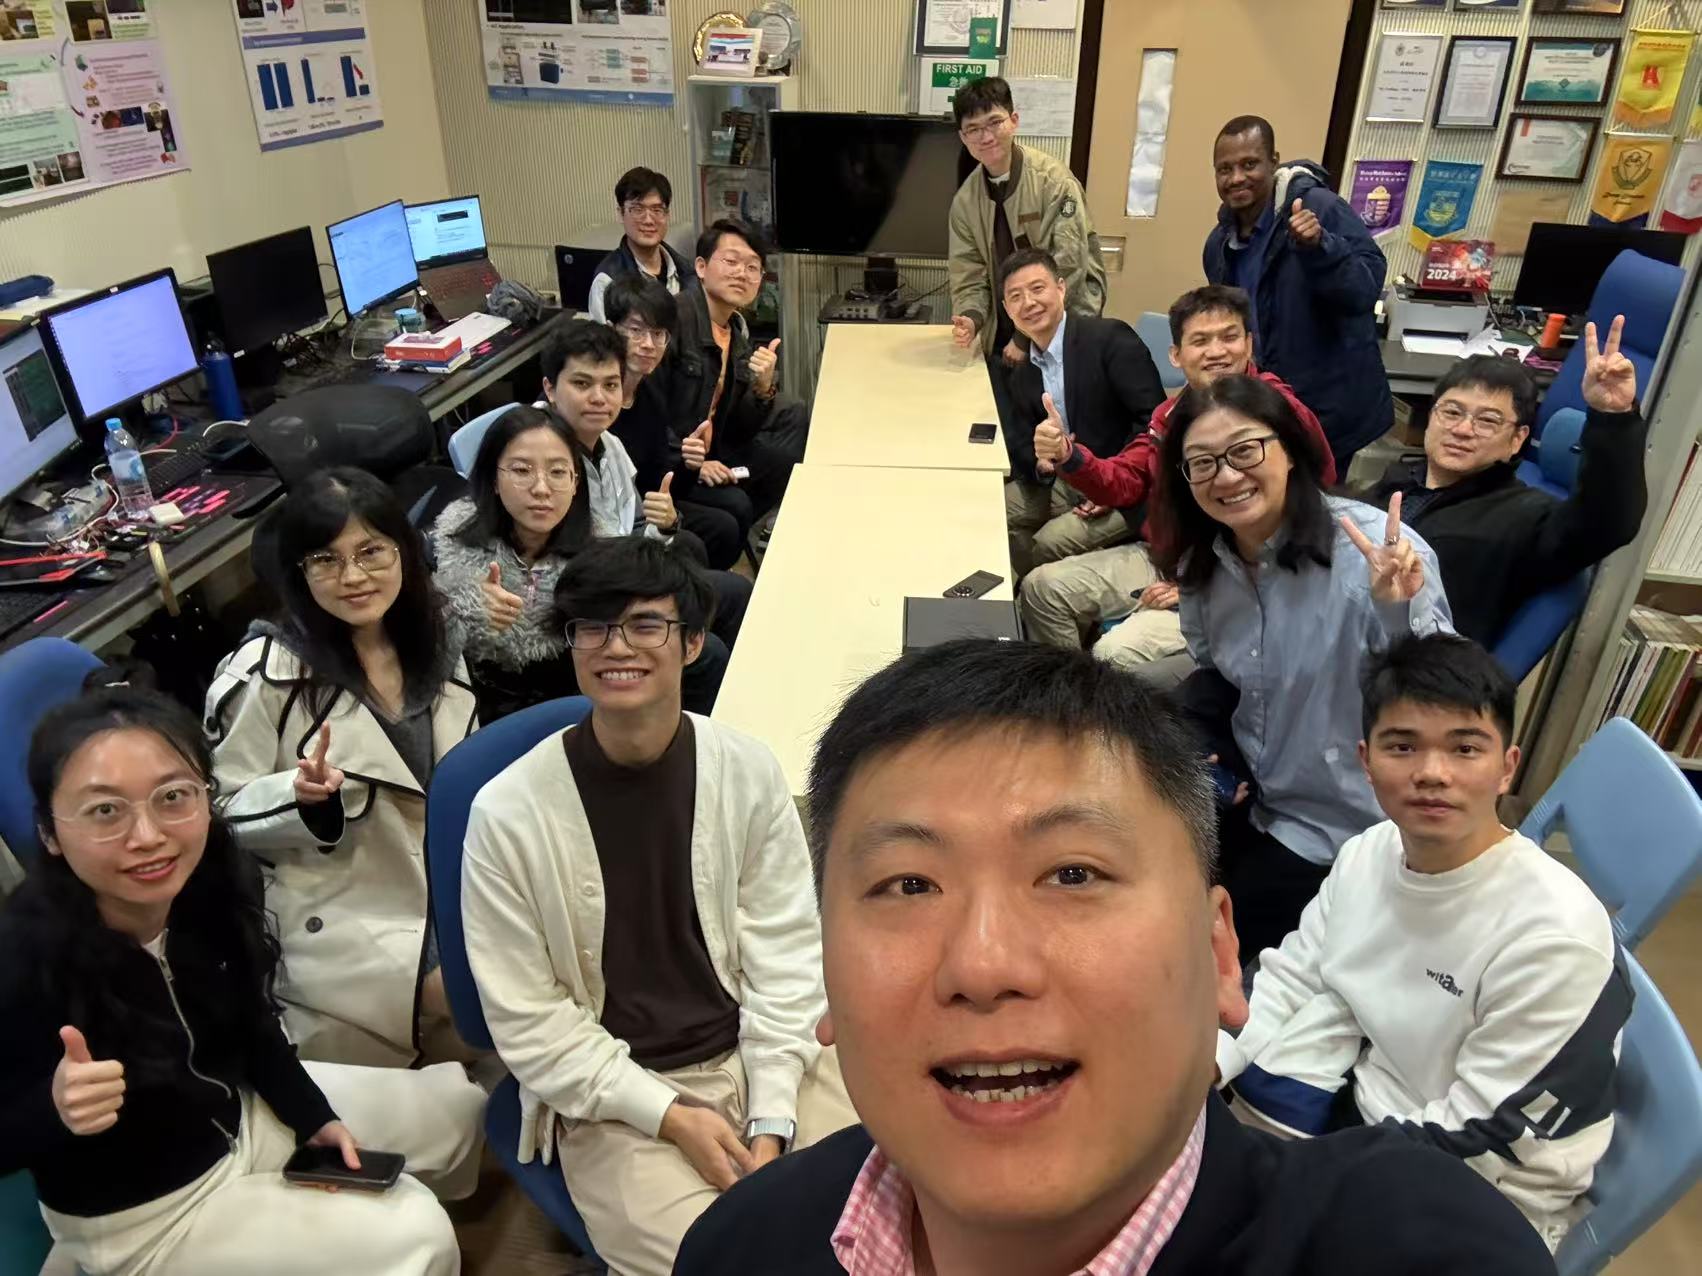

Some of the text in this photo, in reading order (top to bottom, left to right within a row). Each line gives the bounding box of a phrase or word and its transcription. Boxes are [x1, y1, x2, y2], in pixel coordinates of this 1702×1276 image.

[936, 64, 983, 75] FIRST AID
[1426, 269, 1457, 281] 2024
